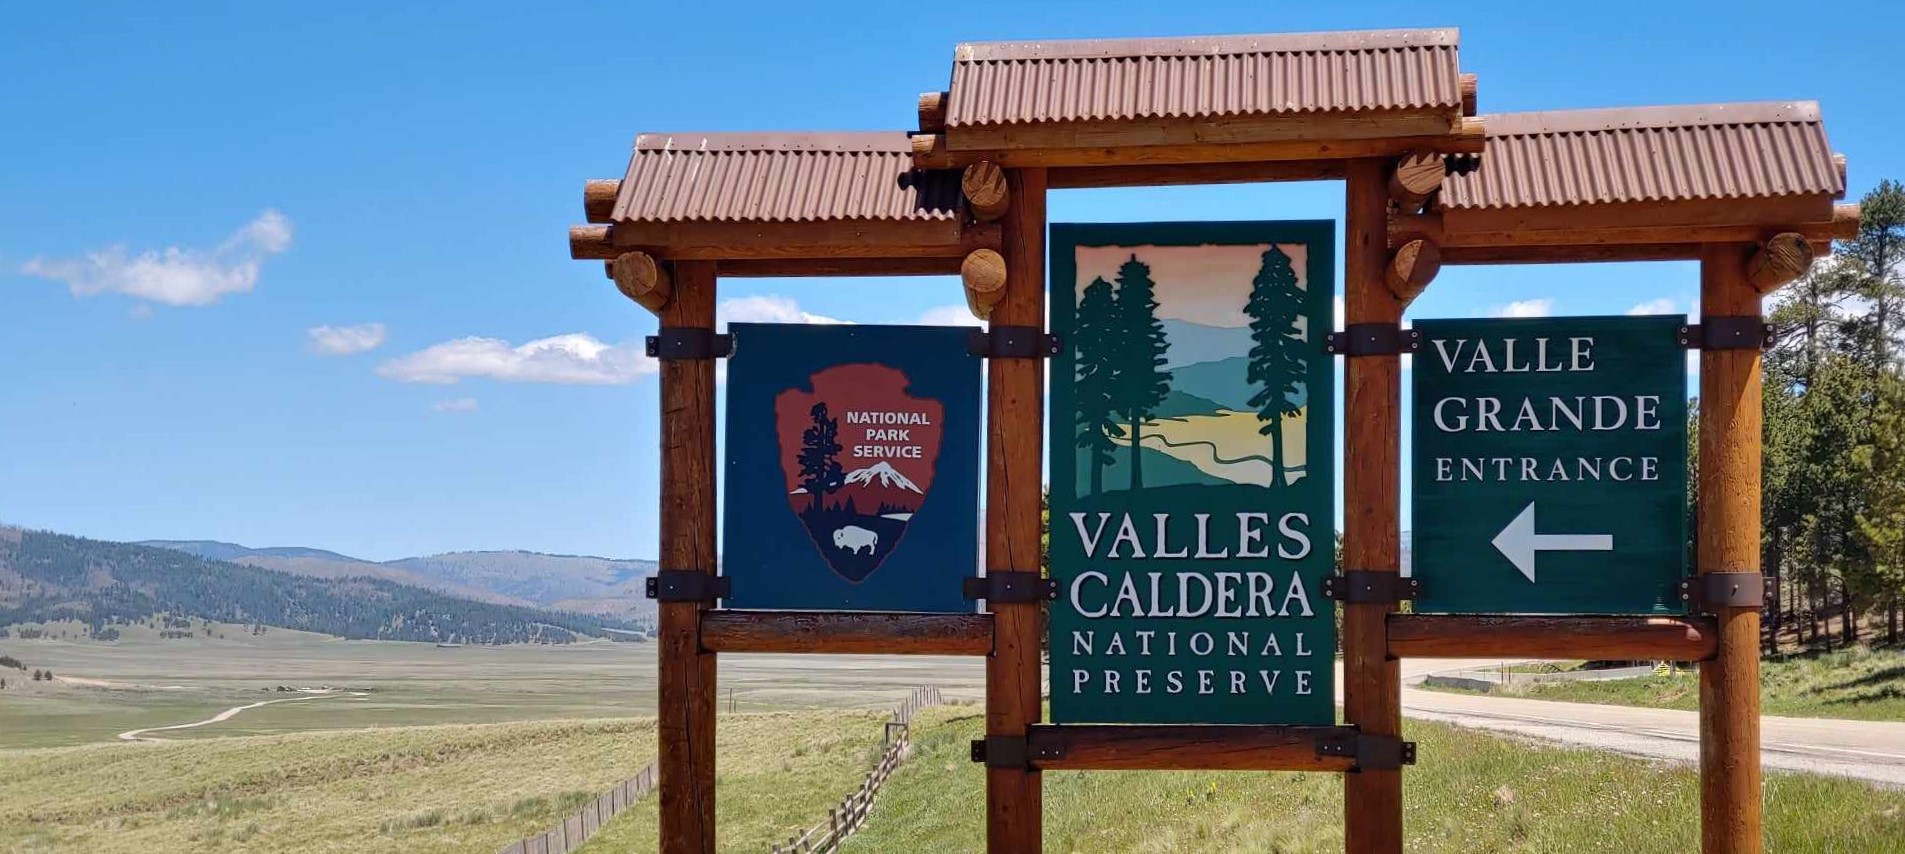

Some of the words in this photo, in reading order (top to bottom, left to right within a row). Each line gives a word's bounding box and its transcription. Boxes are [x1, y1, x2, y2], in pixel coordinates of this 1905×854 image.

[1432, 337, 1596, 374] VALLE
[846, 411, 930, 425] NATIONAL
[1433, 395, 1661, 433] GRANDE
[866, 429, 909, 441] PARK
[853, 445, 922, 458] SERVICE
[1435, 456, 1660, 482] ENTRANCE
[1069, 512, 1311, 559] VALLES
[1070, 571, 1314, 618] CALDERA
[1072, 631, 1312, 656] NATIONAL
[1073, 669, 1312, 695] PRESERVE
